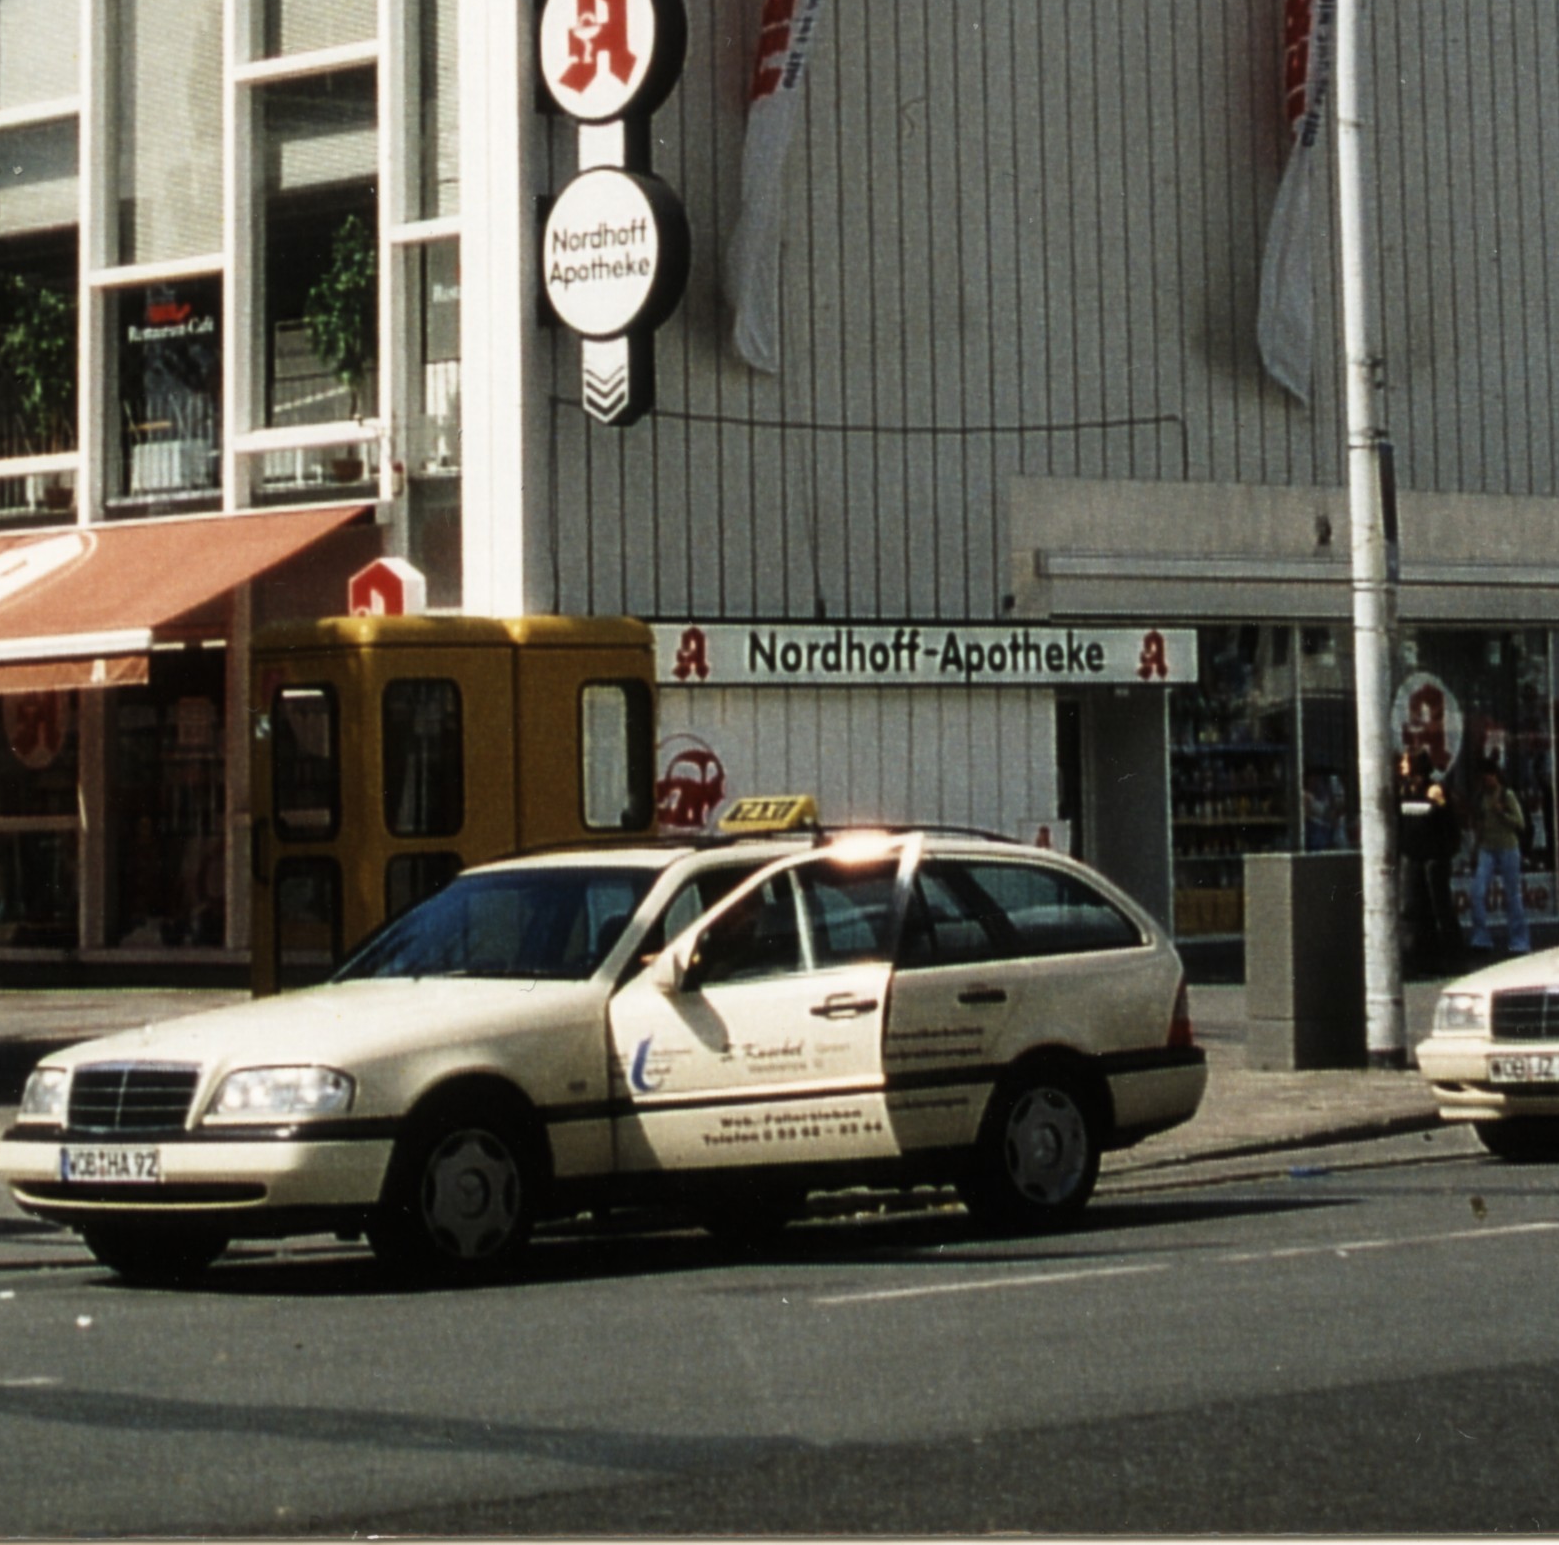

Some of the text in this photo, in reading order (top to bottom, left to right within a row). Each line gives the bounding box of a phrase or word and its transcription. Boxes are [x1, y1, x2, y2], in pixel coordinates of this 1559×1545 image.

[552, 217, 647, 253] Nordhoff
[550, 253, 650, 290] Apotheke
[749, 628, 1105, 681] Nordhoff-Apotheke
